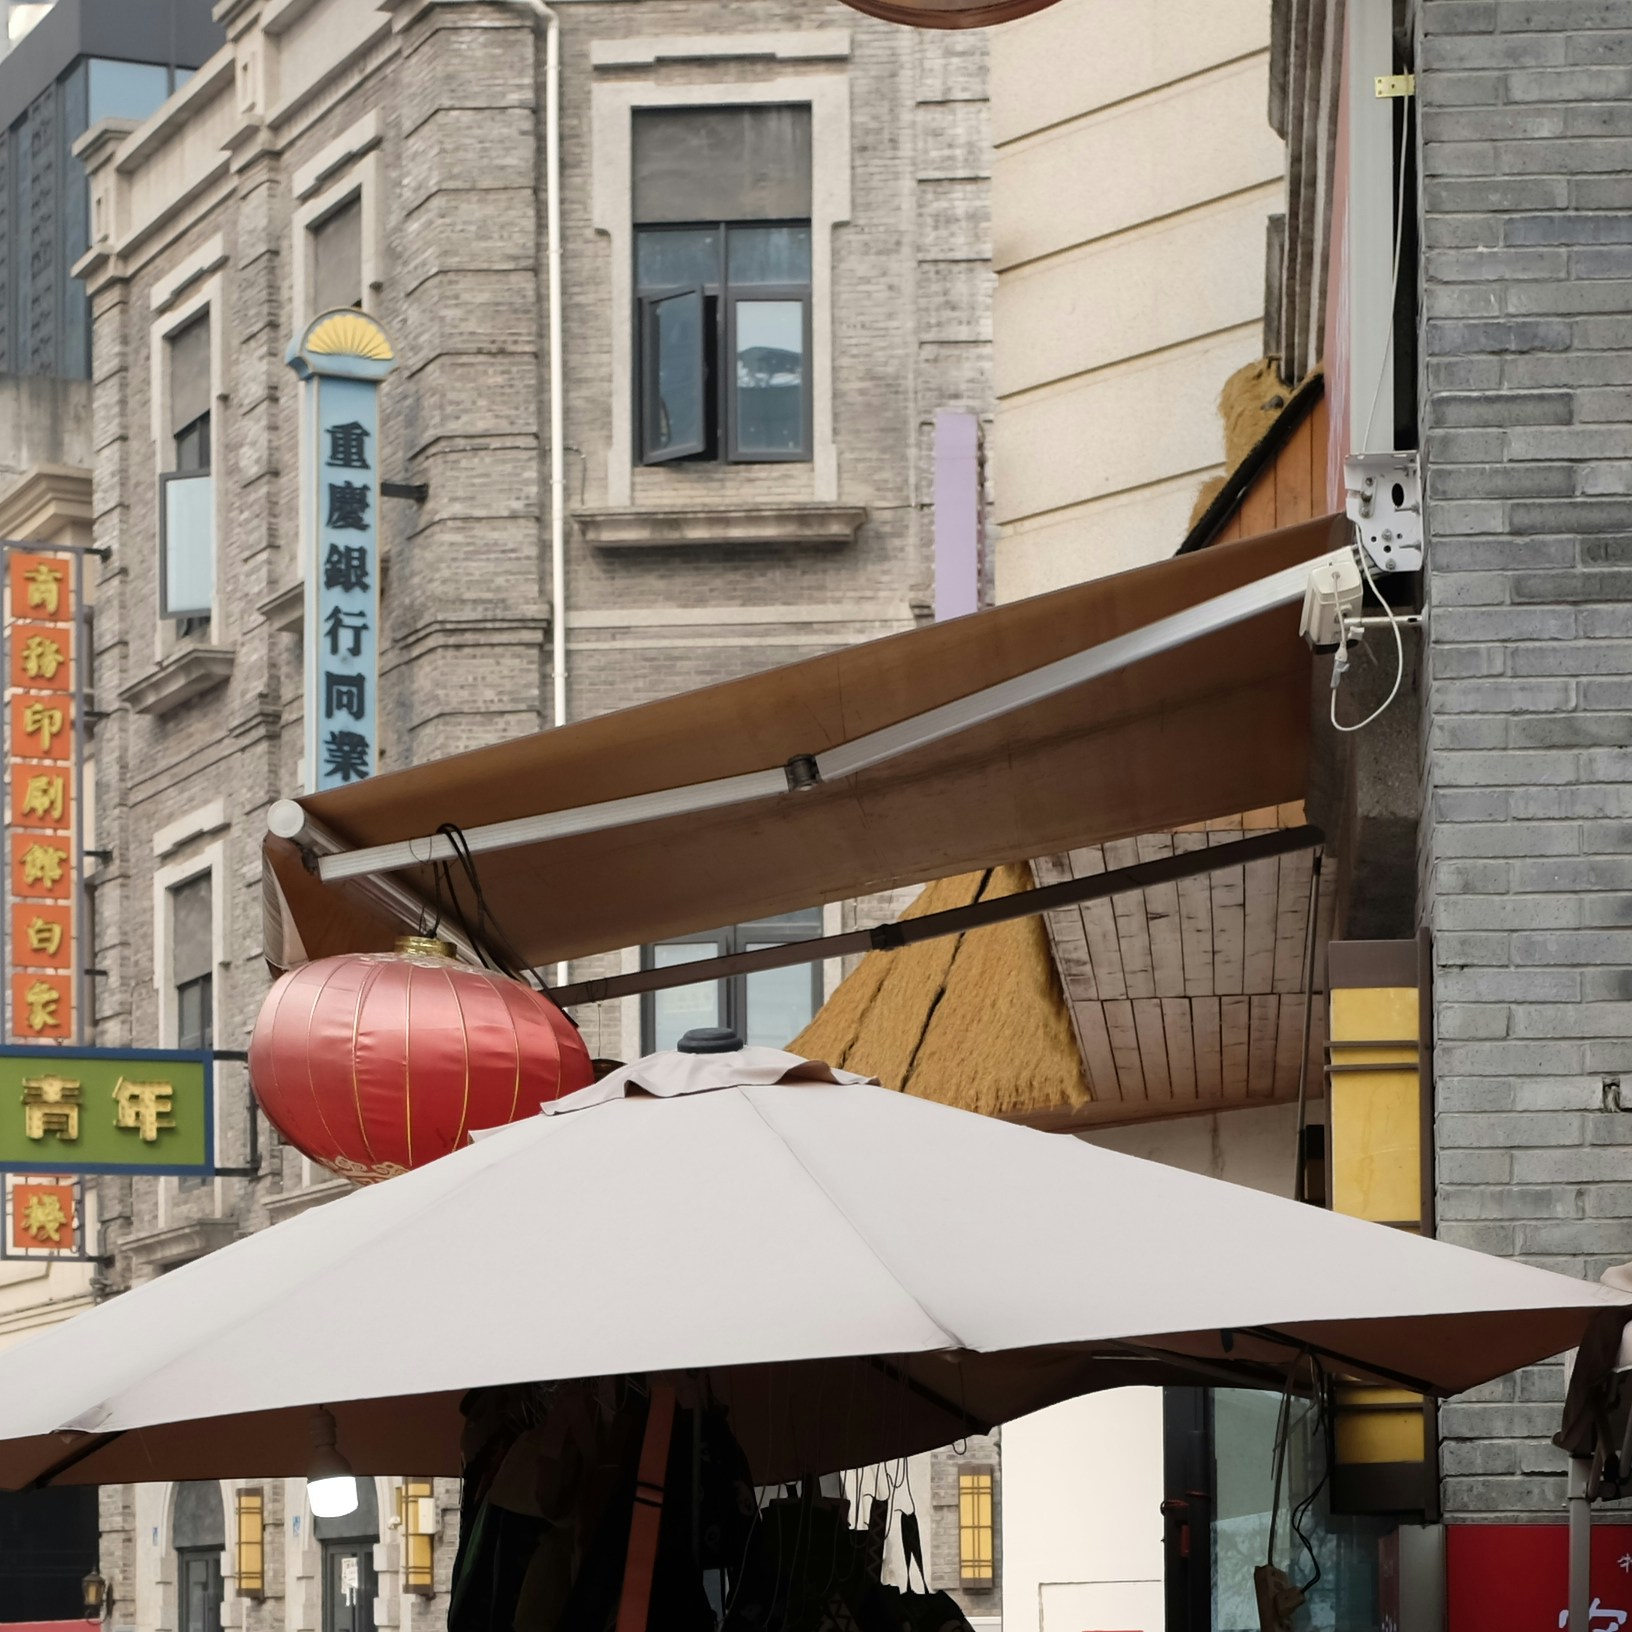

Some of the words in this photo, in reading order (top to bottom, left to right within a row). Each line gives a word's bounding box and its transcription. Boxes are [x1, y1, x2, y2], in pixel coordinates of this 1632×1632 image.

[324, 421, 371, 782] 重慶銀行同業
